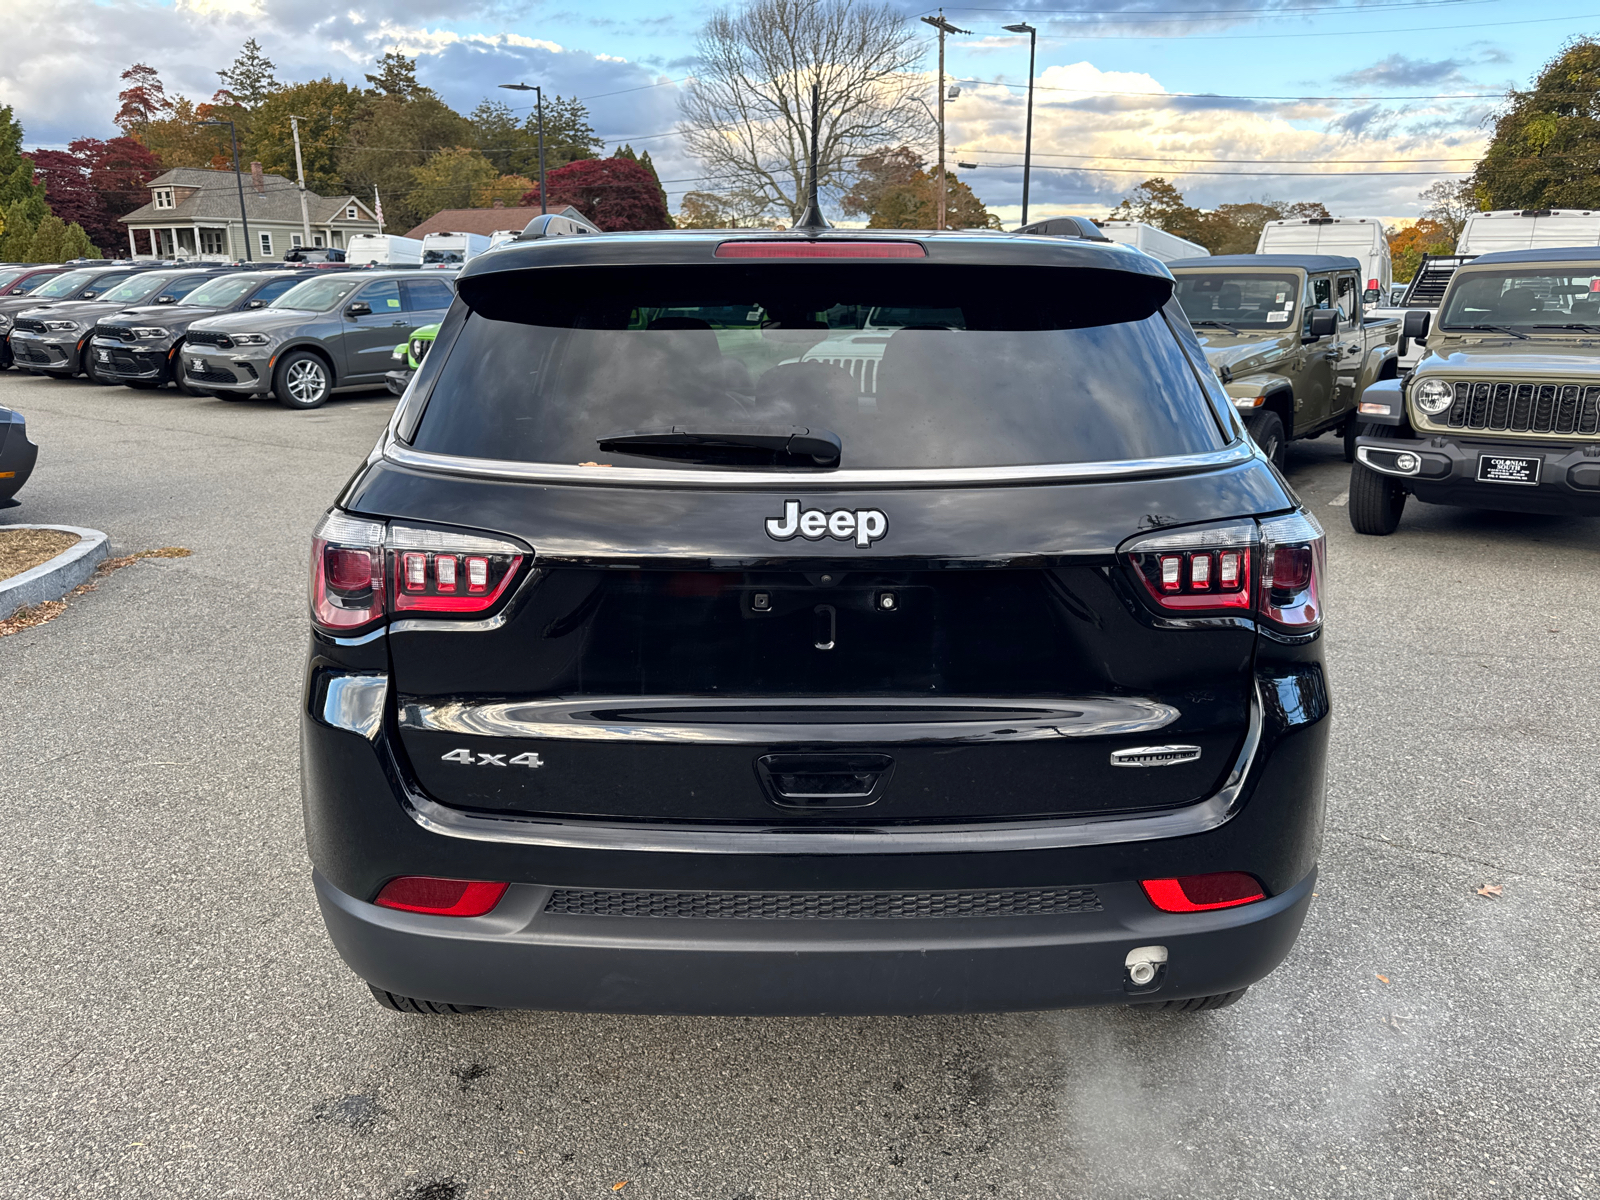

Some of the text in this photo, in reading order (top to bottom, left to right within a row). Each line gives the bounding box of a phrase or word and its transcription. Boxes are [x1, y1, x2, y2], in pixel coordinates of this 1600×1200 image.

[1491, 459, 1528, 467] COLONIAL
[766, 500, 887, 547] Jeep
[441, 748, 544, 768] 4x4
[1118, 753, 1180, 763] LATITUDE
